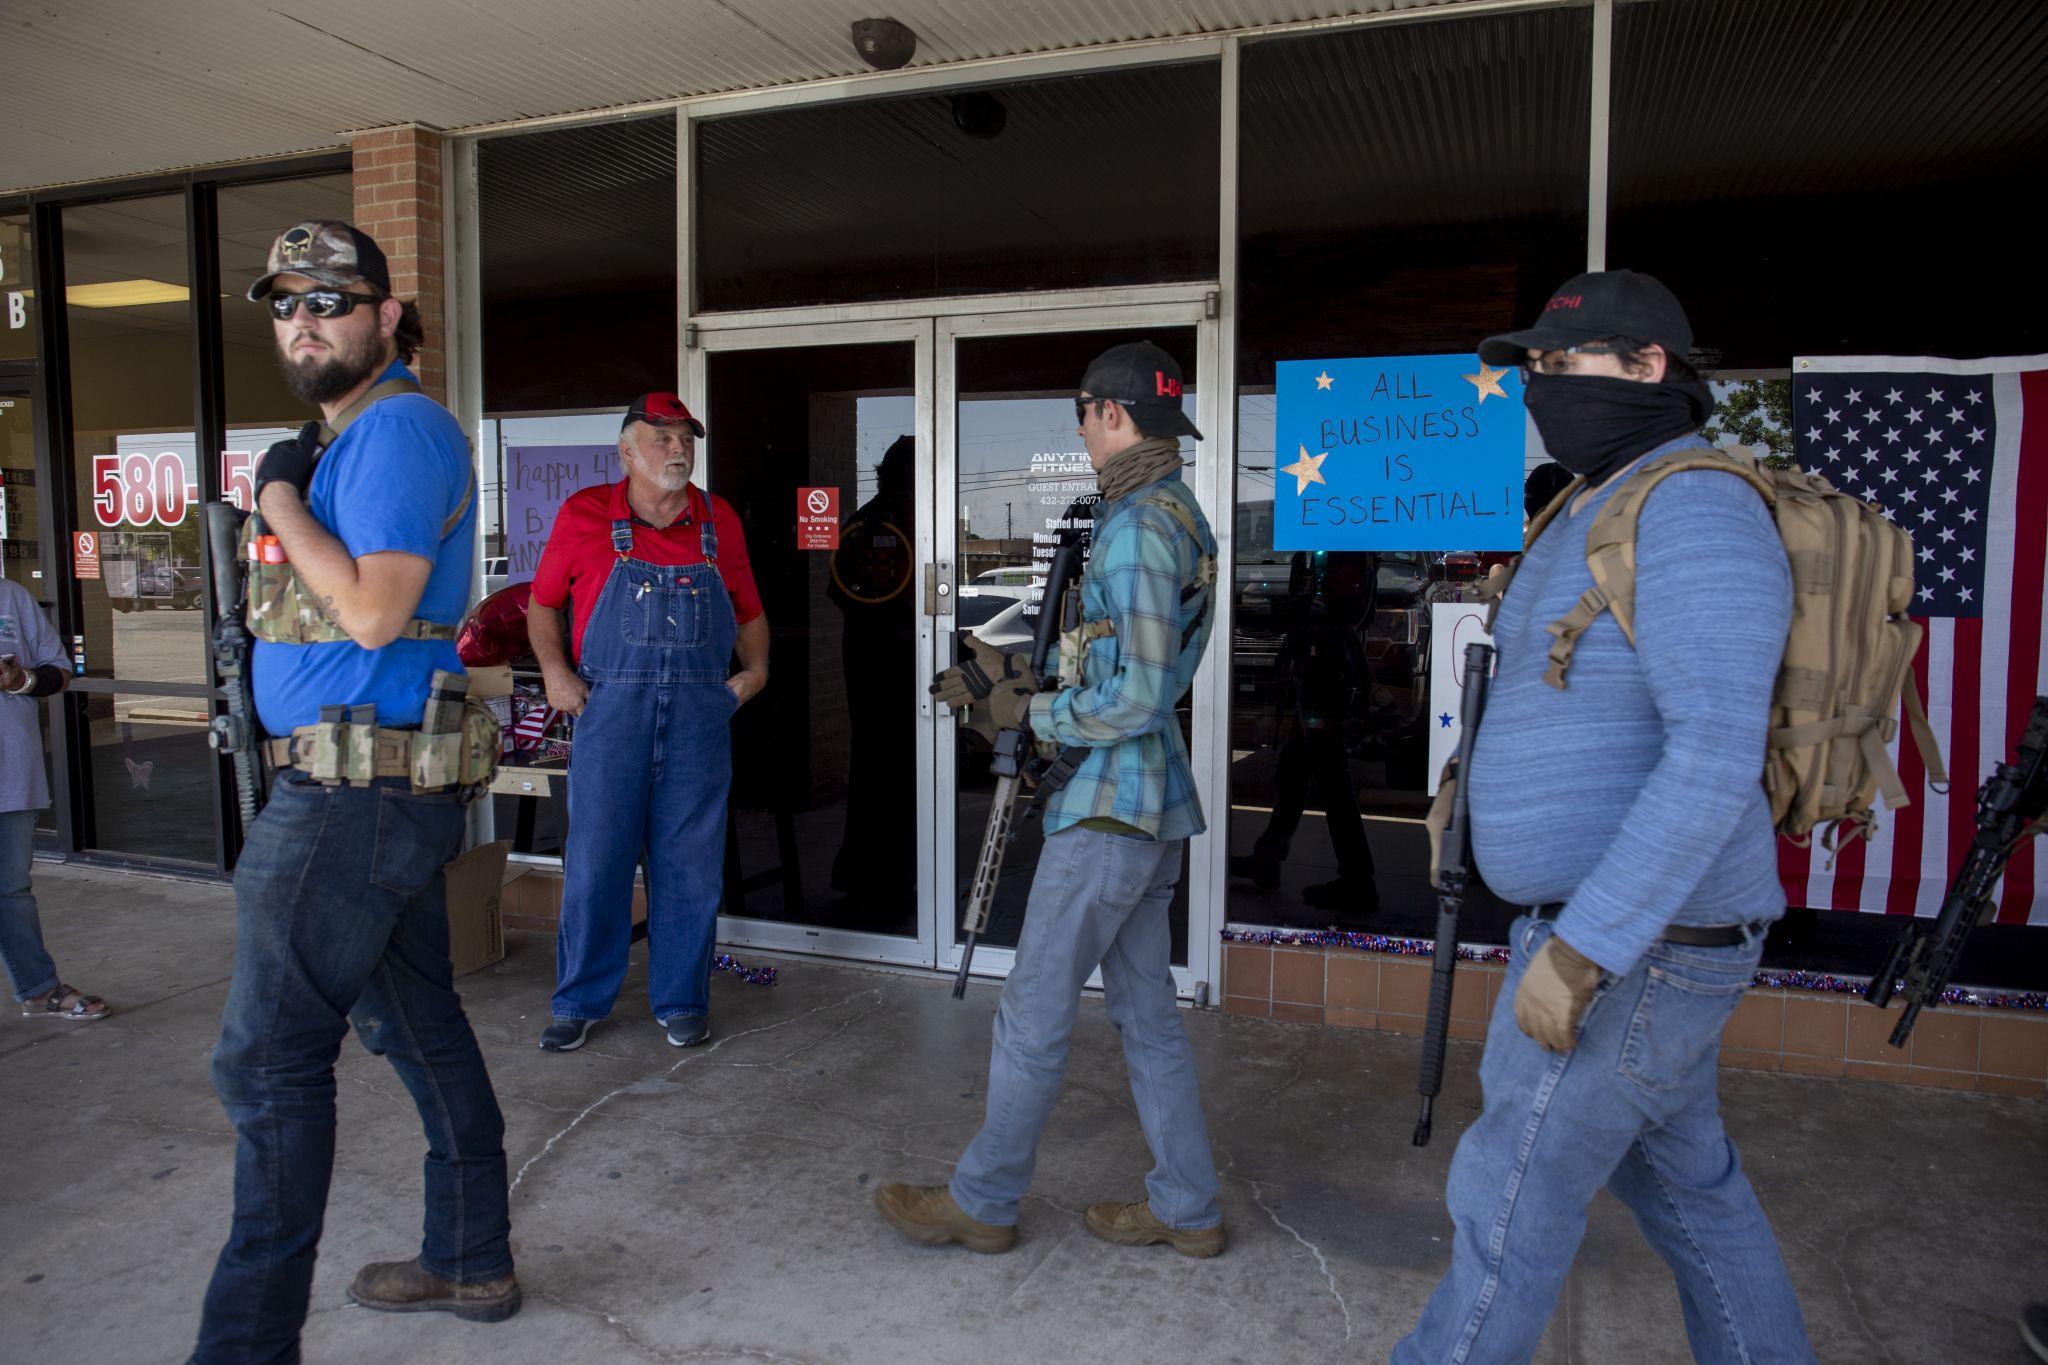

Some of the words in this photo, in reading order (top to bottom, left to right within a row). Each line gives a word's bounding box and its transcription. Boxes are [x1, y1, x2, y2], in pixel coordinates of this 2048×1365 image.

[8, 292, 26, 329] B
[1371, 371, 1432, 400] ALL
[1320, 407, 1479, 449] BUSINESS
[516, 452, 579, 501] happy
[1030, 463, 1095, 473] FITNES
[1385, 454, 1413, 481] IS
[1028, 482, 1059, 491] GUEST
[1062, 482, 1097, 492] ENTRA
[810, 516, 837, 524] Smoking
[1045, 517, 1072, 529] Staffed
[1073, 517, 1095, 529] Hours
[1033, 532, 1061, 544] Monday
